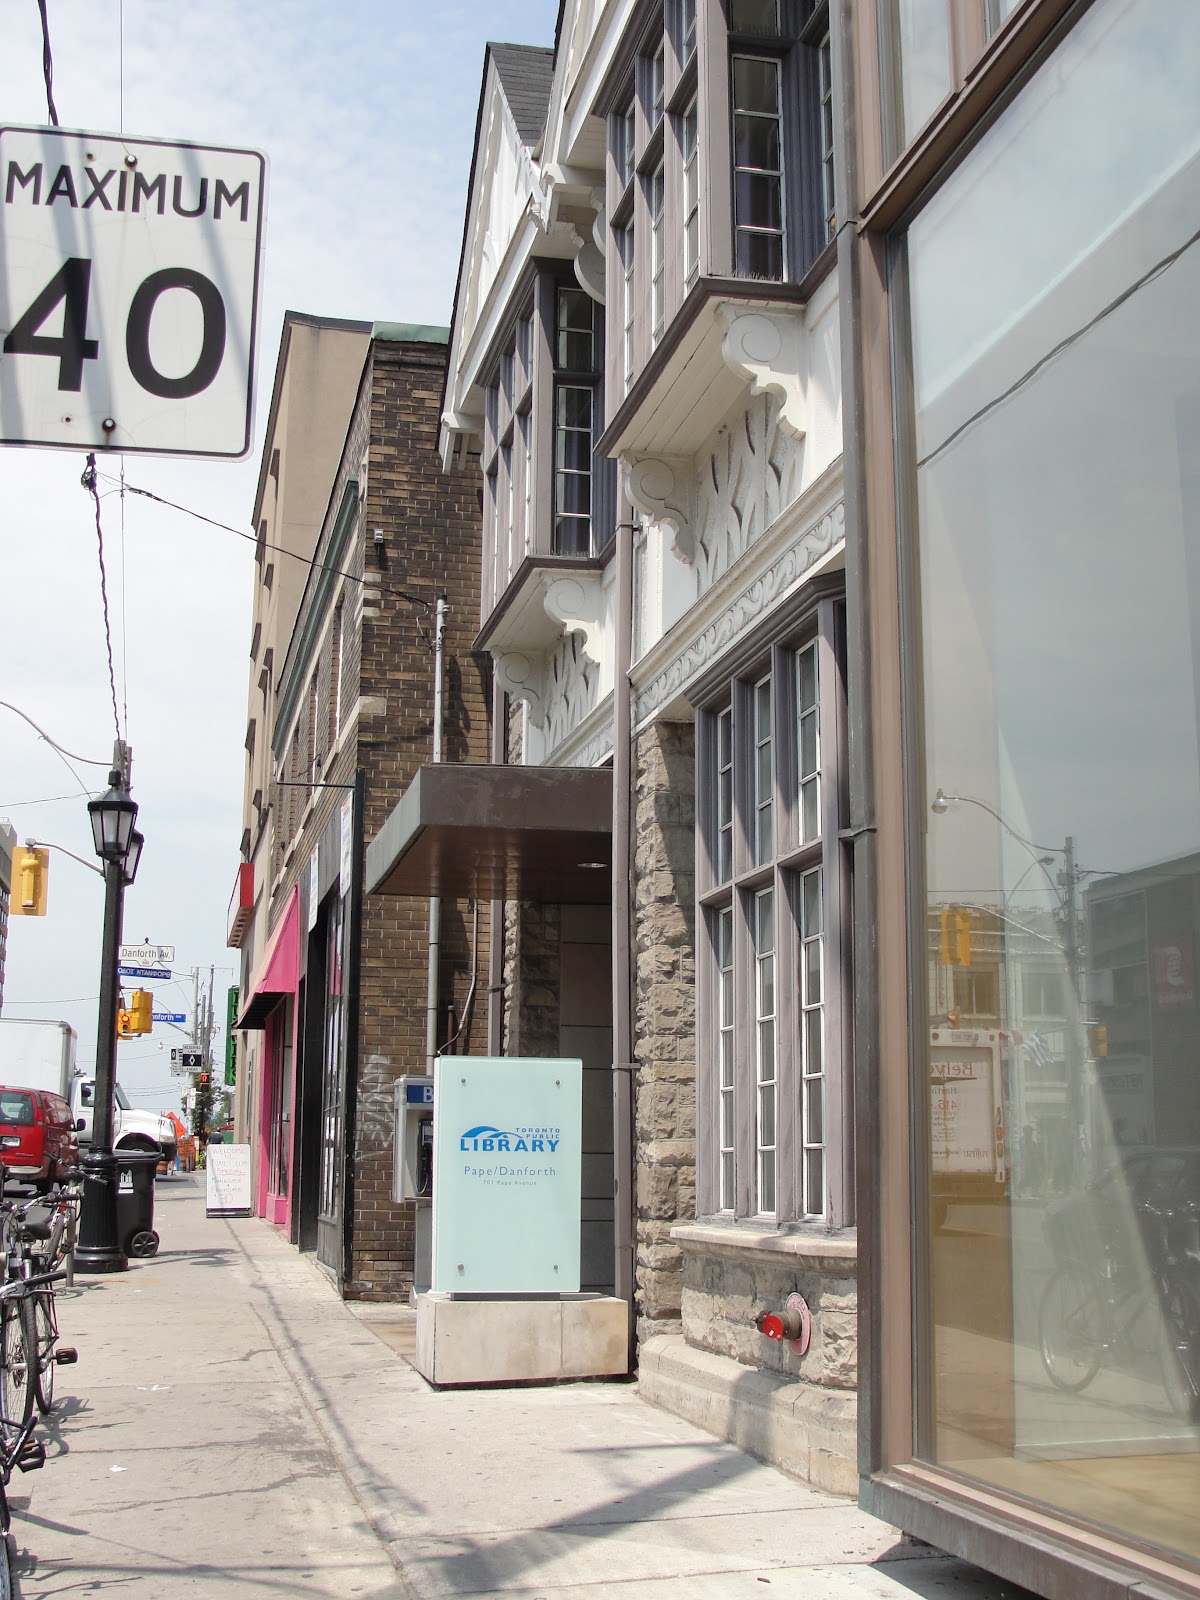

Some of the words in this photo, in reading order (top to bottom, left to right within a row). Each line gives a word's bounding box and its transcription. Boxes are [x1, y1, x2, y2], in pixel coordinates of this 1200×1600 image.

[6, 160, 250, 222] MAXIMUM
[3, 257, 228, 399] 40
[122, 948, 156, 958] Danforth
[159, 949, 171, 958] Av.
[460, 1138, 560, 1152] LIBRARY
[464, 1165, 556, 1178] Pape/Danforth
